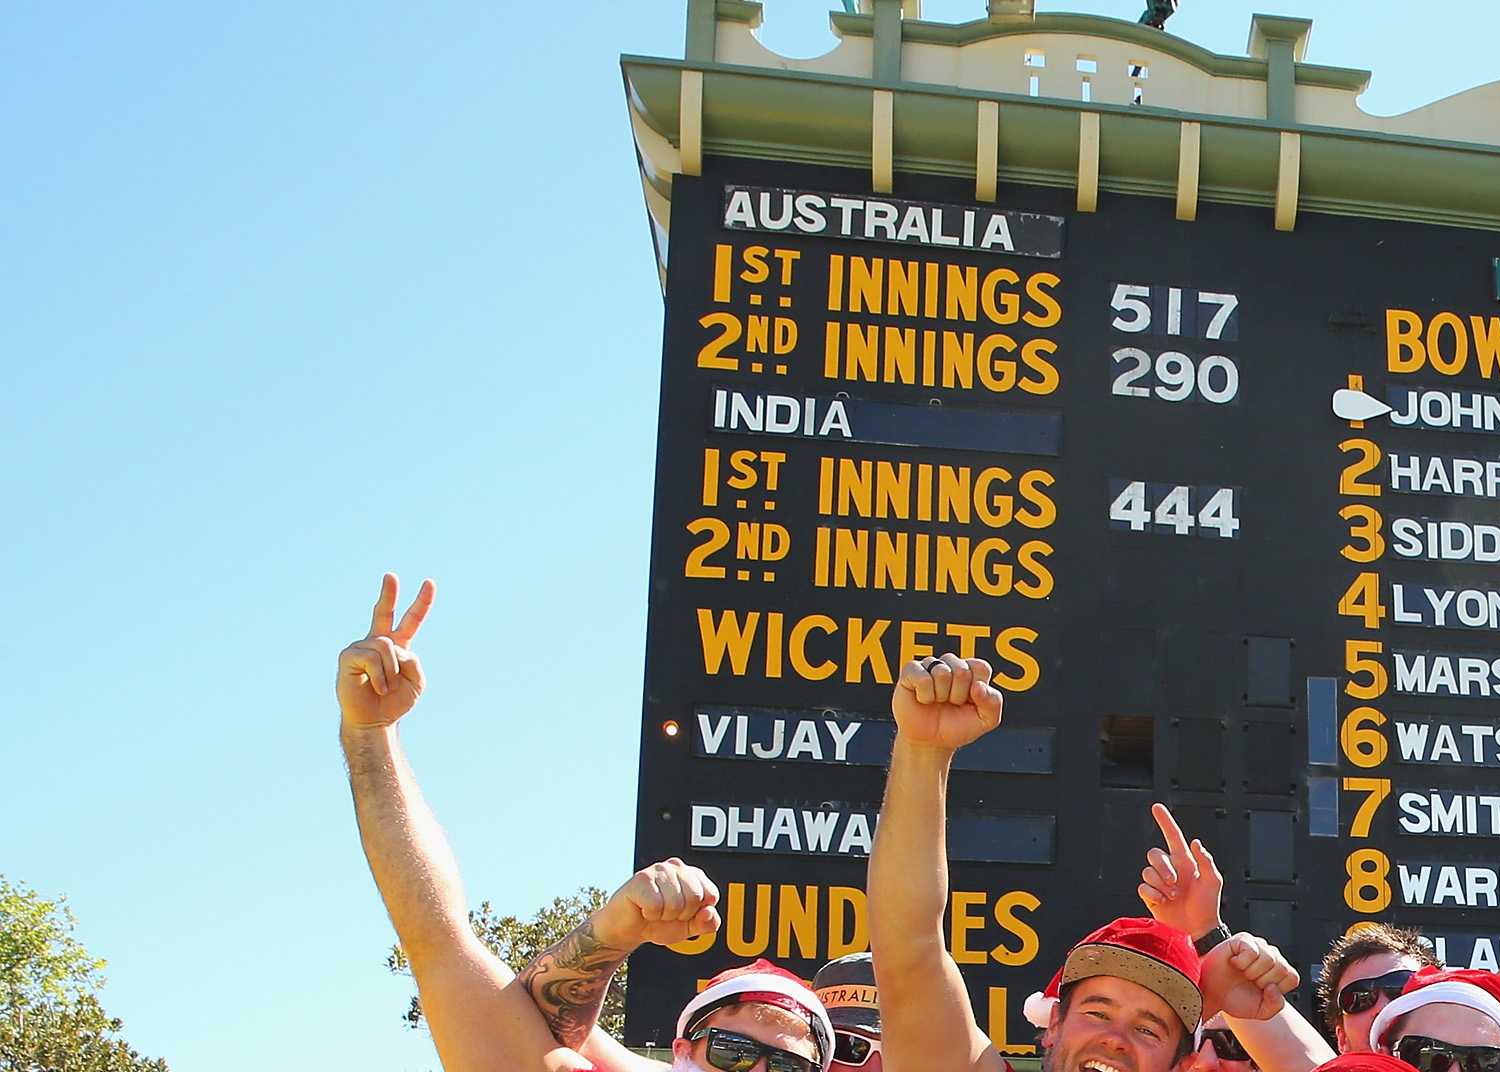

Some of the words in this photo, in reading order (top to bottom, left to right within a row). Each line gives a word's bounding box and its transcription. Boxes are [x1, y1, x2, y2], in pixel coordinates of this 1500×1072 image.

[725, 192, 1014, 251] AUSTRALIA
[828, 256, 1062, 328] INNINGS
[1110, 284, 1238, 339] 517
[824, 322, 1060, 394] INNINGS
[1111, 347, 1239, 403] 290
[713, 389, 852, 437] INDIA
[819, 457, 1056, 528] INNINGS
[1110, 481, 1240, 537] 444
[1338, 438, 1382, 496] 2
[815, 527, 1053, 598] INNINGS
[1337, 505, 1384, 563] 3
[1338, 572, 1385, 629] 4
[697, 608, 1040, 692] WICKETS
[1344, 640, 1388, 699] 5
[697, 714, 862, 762] VIJAY
[1341, 707, 1387, 768] 6
[691, 806, 880, 853] DHAWA
[1343, 777, 1391, 837] 7
[1344, 848, 1391, 913] 8
[666, 882, 1040, 966] UNDES
